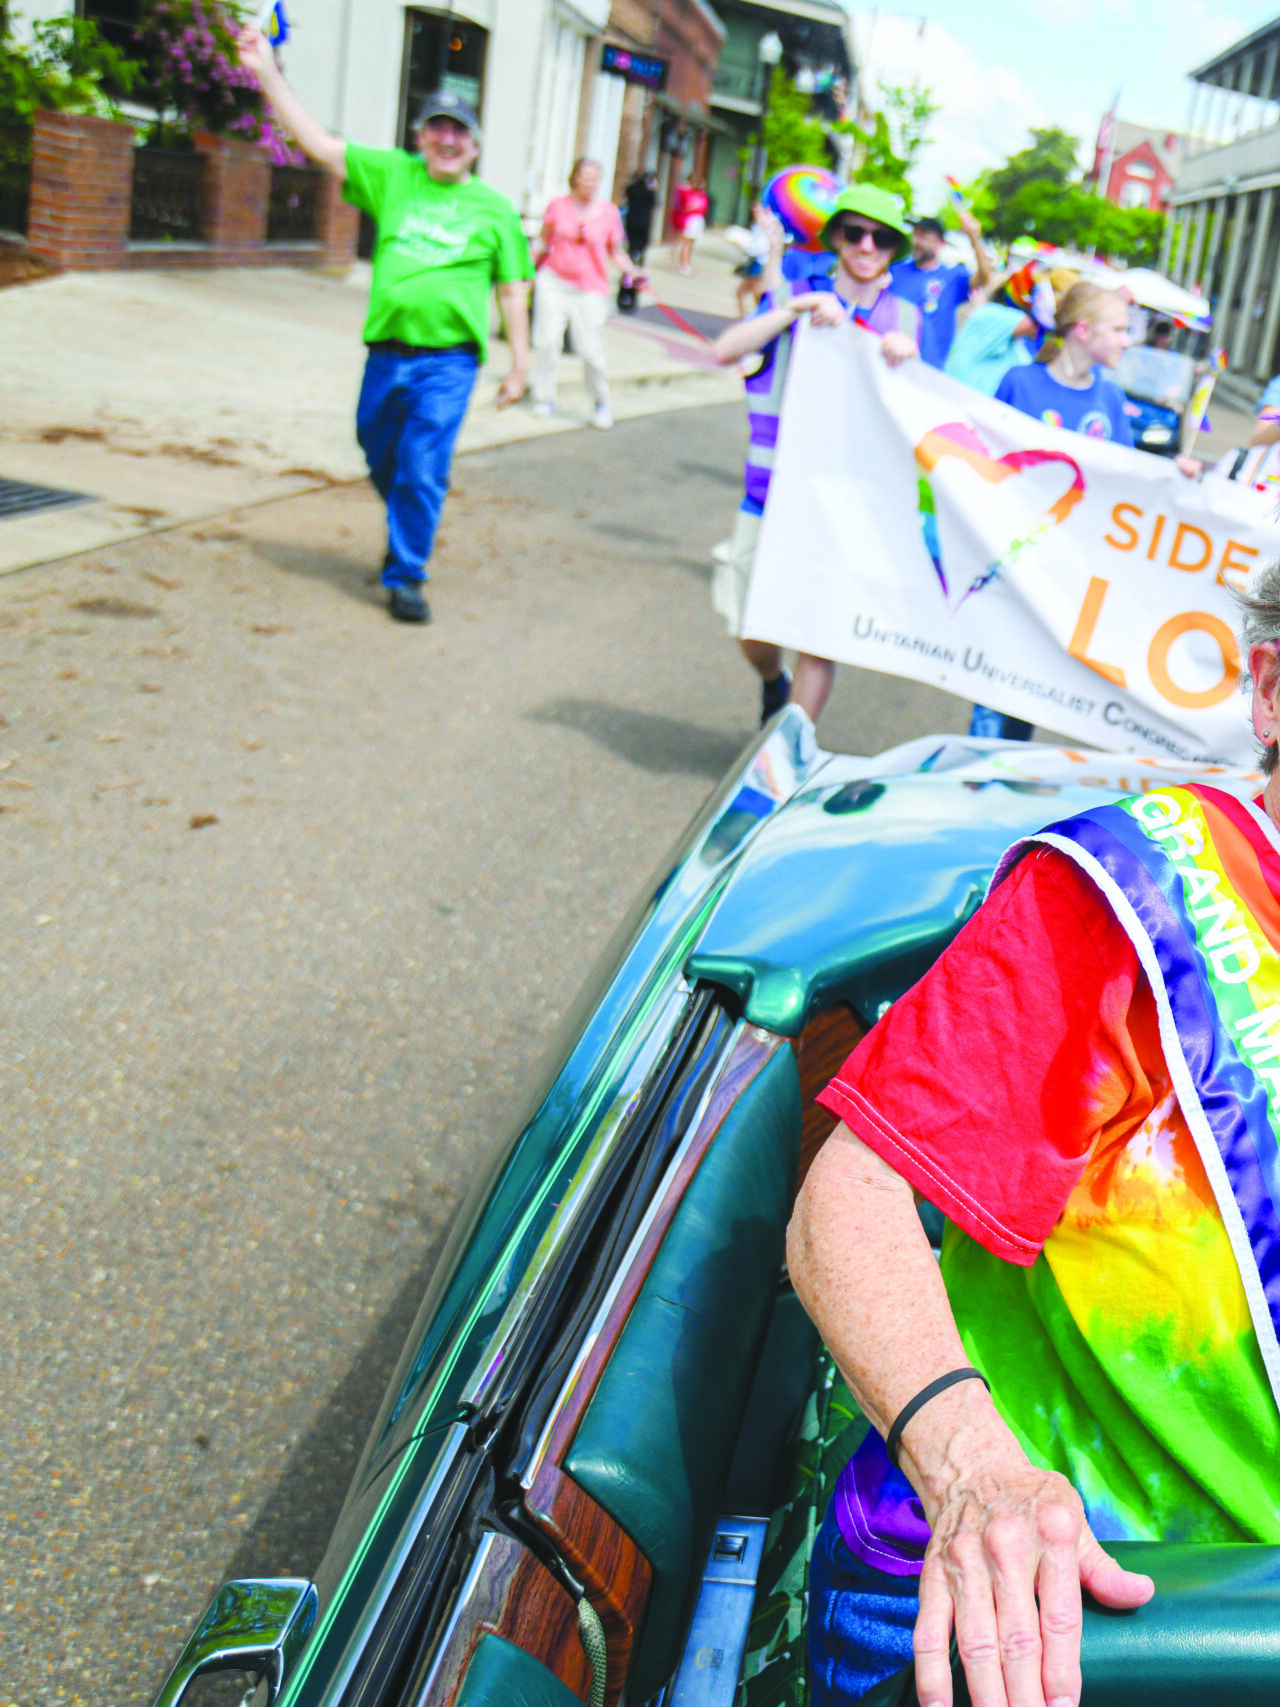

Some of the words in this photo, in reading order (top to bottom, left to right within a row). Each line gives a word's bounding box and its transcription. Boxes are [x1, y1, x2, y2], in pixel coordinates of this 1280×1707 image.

[1104, 502, 1260, 591] SIDE
[1066, 576, 1240, 709] LO
[1130, 793, 1260, 984] GRAND
